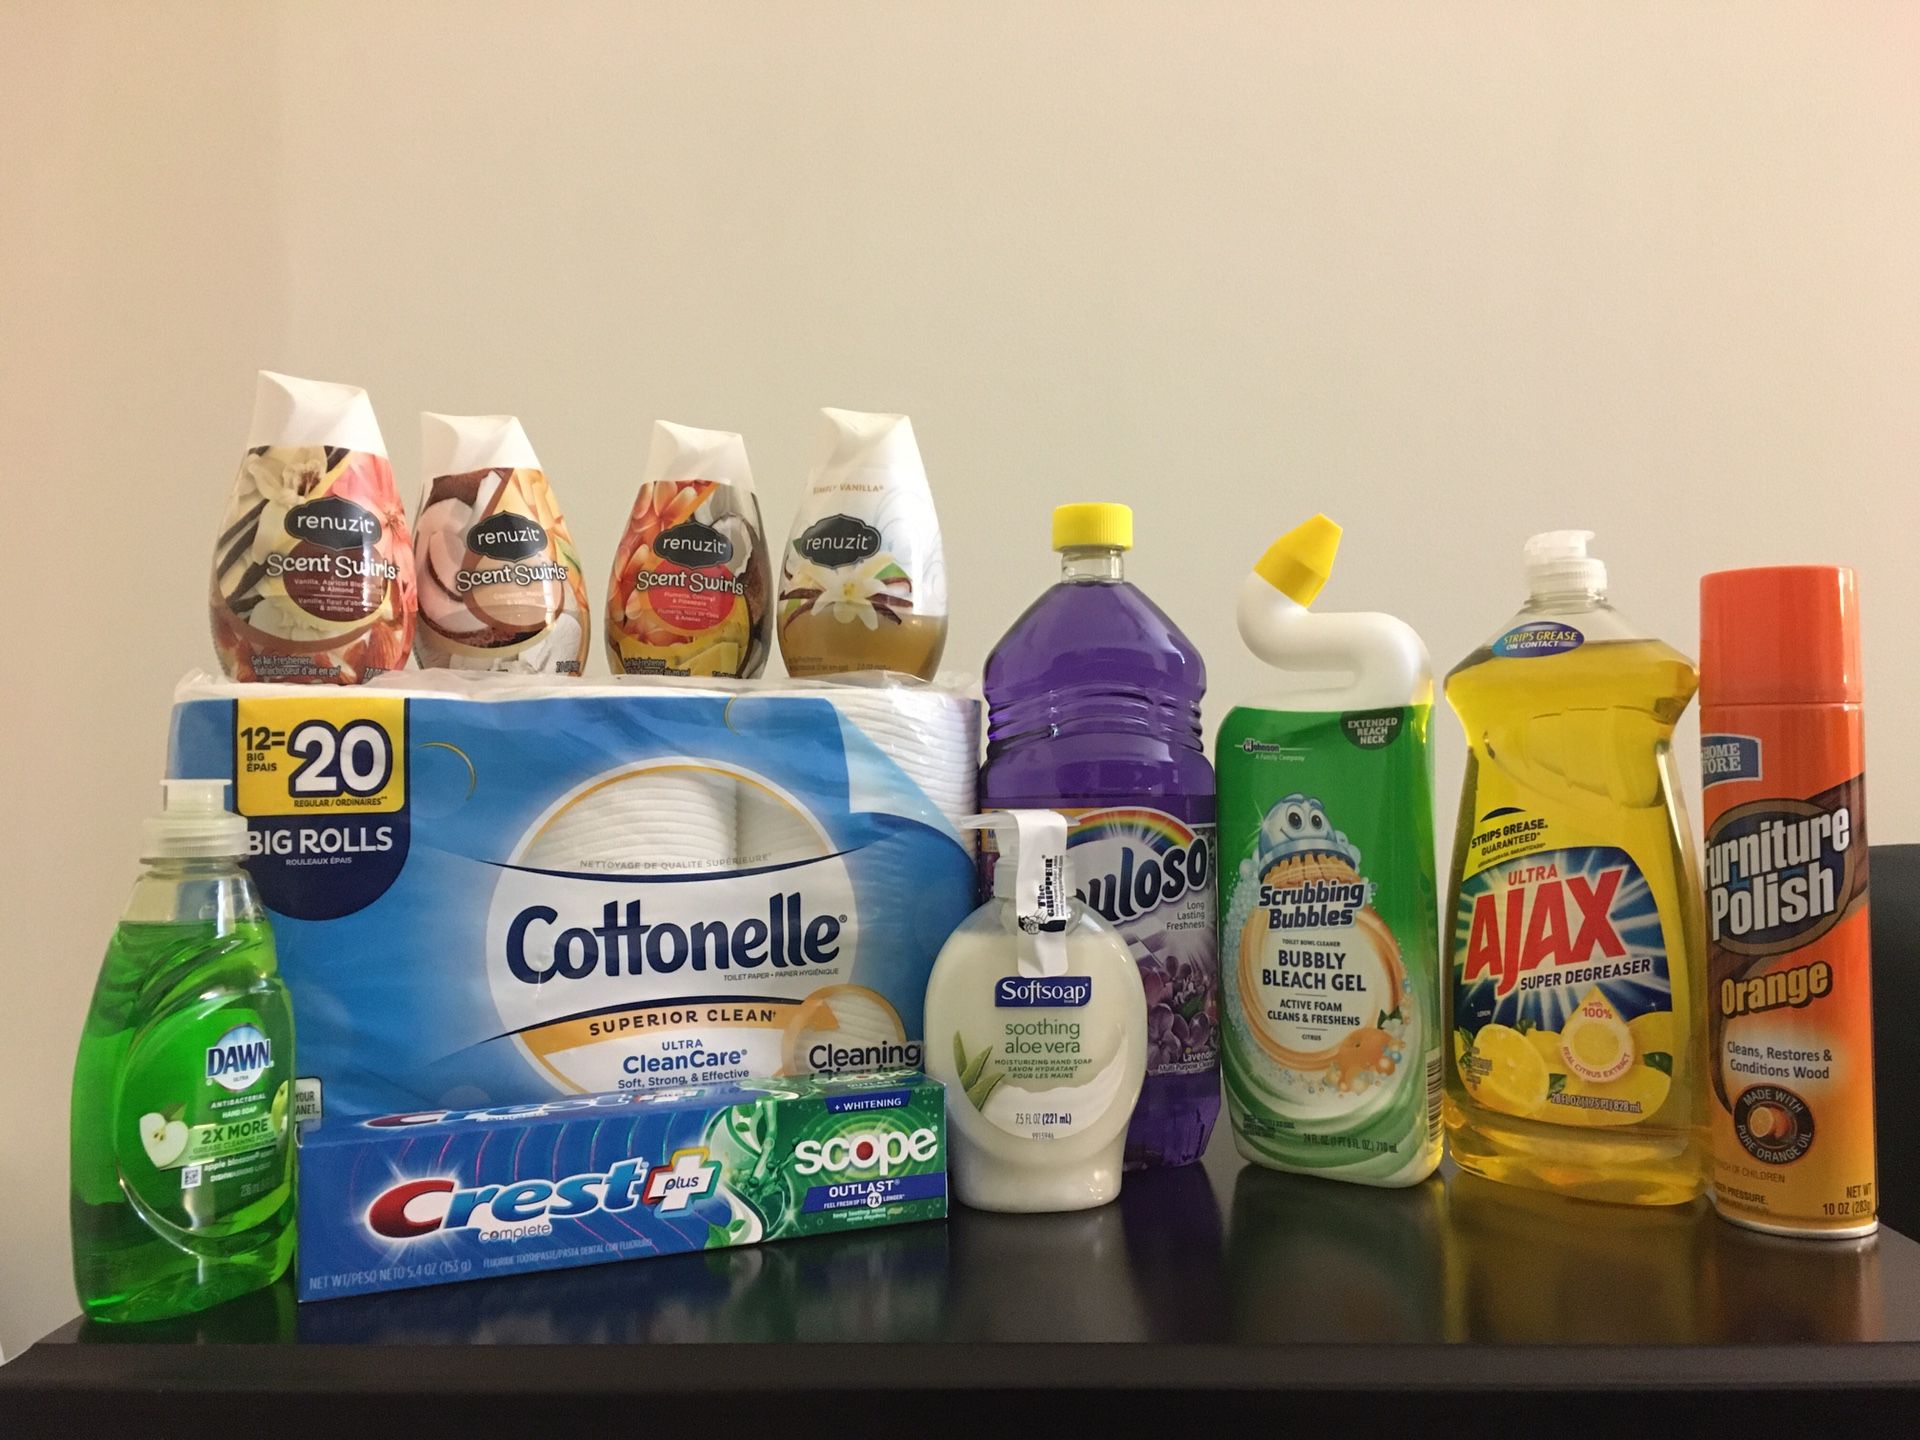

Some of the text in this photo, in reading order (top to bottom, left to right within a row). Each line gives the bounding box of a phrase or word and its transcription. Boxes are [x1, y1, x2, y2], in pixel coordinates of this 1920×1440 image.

[297, 513, 373, 534] renuzit
[477, 527, 538, 545] renuzit
[663, 538, 724, 554] renuzit
[805, 534, 869, 551] renuzit
[266, 553, 397, 580] Scent Swirls
[456, 562, 566, 592] Scent Swirls
[636, 571, 744, 595] Scent Swirls
[1503, 630, 1578, 645] STRIPS GREASE
[1520, 641, 1559, 649] CONTACT
[1347, 717, 1398, 729] EXTENDED
[1356, 727, 1388, 736] REACH
[1359, 735, 1386, 745] NECK
[246, 752, 265, 762] BIG
[246, 762, 277, 772] ÉPAIS
[290, 721, 390, 796] 20
[1279, 754, 1305, 762] Company
[1703, 756, 1742, 774] TORE
[294, 797, 382, 808] REGULAR ORDINAIRES
[246, 826, 392, 856] BIG ROLLS
[1471, 818, 1548, 849] STRIPS GREASE.
[286, 857, 352, 866] ROULEAUX ÉPAIS
[580, 860, 640, 870] NETTOYAGE
[644, 862, 657, 870] DE
[1078, 838, 1209, 922] uloso
[1507, 863, 1558, 886] ULTRA
[1258, 881, 1365, 908] Scrubbing
[1711, 862, 1834, 942] Polish
[1177, 910, 1205, 921] Lasting
[1187, 901, 1205, 911] Long
[1166, 920, 1205, 931] Freshness
[1268, 904, 1353, 930] Bubbles
[506, 891, 841, 985] Cottonelle
[1462, 868, 1627, 997] AJAX
[1282, 938, 1341, 948] TOILET BOWL CLEANER
[1278, 949, 1346, 970] BUBBLY
[724, 973, 747, 982] TOILET
[747, 972, 770, 980] PAPER
[775, 970, 798, 978] PAPIER
[1262, 969, 1367, 992] BLEACH GEL
[1520, 958, 1651, 991] SUPER DEGREASER
[1001, 980, 1085, 1004] Softsoap
[1720, 961, 1829, 1018] Orange
[1280, 999, 1342, 1013] ACTIVE FOAM
[1582, 1007, 1613, 1020] 100%
[589, 1010, 698, 1036] SUPERIOR
[1005, 1018, 1080, 1039] soothing
[1267, 1010, 1361, 1027] CLEANS & FRESHENS
[662, 1038, 703, 1051] ULTRA
[808, 1040, 922, 1069] Cleaning
[1005, 1037, 1080, 1054] aloe vera
[1727, 1041, 1832, 1062] Cleans, Restores &
[207, 1039, 270, 1078] DAWN
[623, 1049, 741, 1074] CleanCare
[1562, 1046, 1631, 1079] REAL CITRUS EXTRACT
[618, 1068, 749, 1089] Soft, Strong, & Effective
[1730, 1059, 1830, 1079] Conditions Wood
[210, 1093, 266, 1109] ANTIBACTERIAL
[843, 1097, 902, 1111] WHITENING
[1613, 1100, 1629, 1112] 828
[1743, 1089, 1804, 1113] MADE WITH
[1025, 1112, 1032, 1125] FL
[1033, 1112, 1041, 1125] OZ
[1042, 1112, 1058, 1126] (221
[201, 1119, 269, 1145] 2X MORE
[794, 1127, 938, 1176] scope
[1737, 1125, 1812, 1163] PURE ORANGE OIL
[663, 1176, 699, 1195] plus
[1742, 1168, 1786, 1184] CHILDREN
[368, 1157, 642, 1240] Crest
[829, 1179, 895, 1198] OUTLAST
[1846, 1182, 1873, 1199] NET WT
[868, 1195, 880, 1206] 7X
[1822, 1202, 1850, 1216] 10 OZ
[479, 1221, 552, 1243] complete
[483, 1255, 514, 1268] FLUORIDE
[580, 1243, 604, 1256] DENTAL
[309, 1274, 328, 1290] NET
[379, 1267, 405, 1282] NETO
[407, 1264, 422, 1278] 5.4
[424, 1262, 437, 1276] OZ
